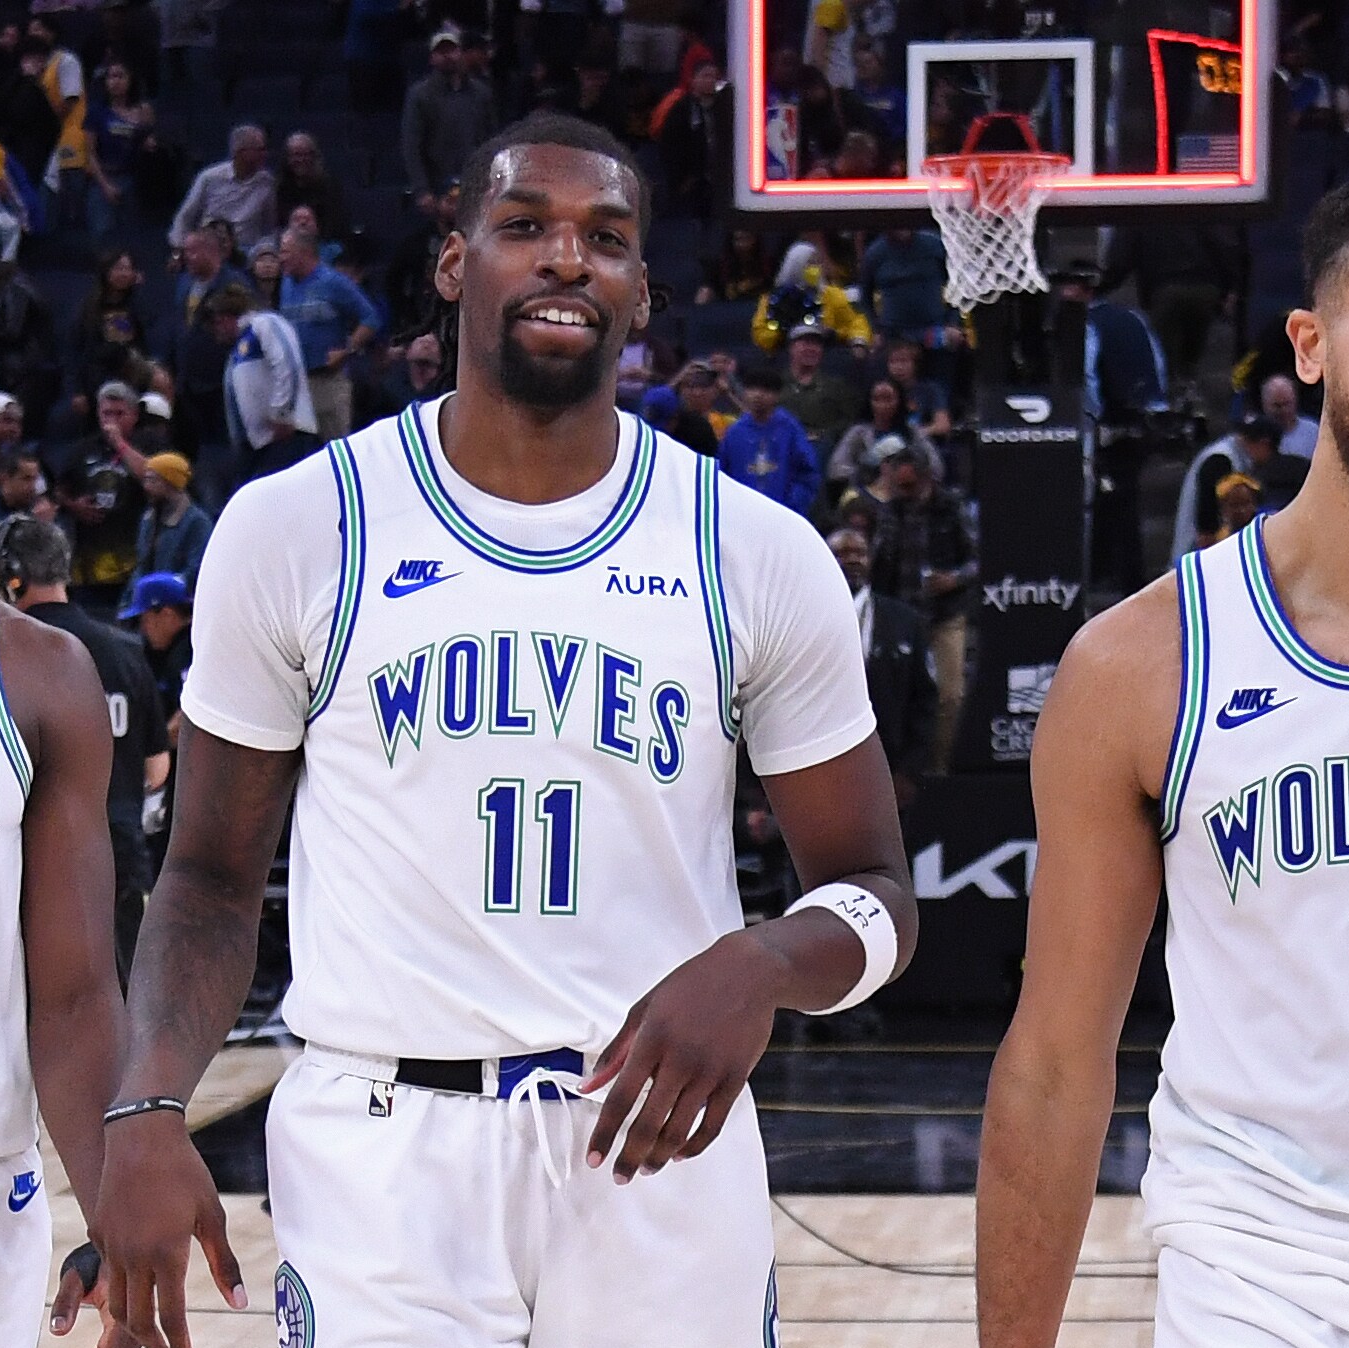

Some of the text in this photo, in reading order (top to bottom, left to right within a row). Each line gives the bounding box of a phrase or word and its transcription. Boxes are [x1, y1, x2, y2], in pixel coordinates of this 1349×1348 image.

[980, 429, 1076, 443] DOORDASH
[395, 559, 444, 582] NIKE
[983, 576, 1080, 612] xfinity
[367, 629, 691, 785] WOLVES
[1228, 687, 1278, 712] NIKE
[477, 777, 582, 916] 11
